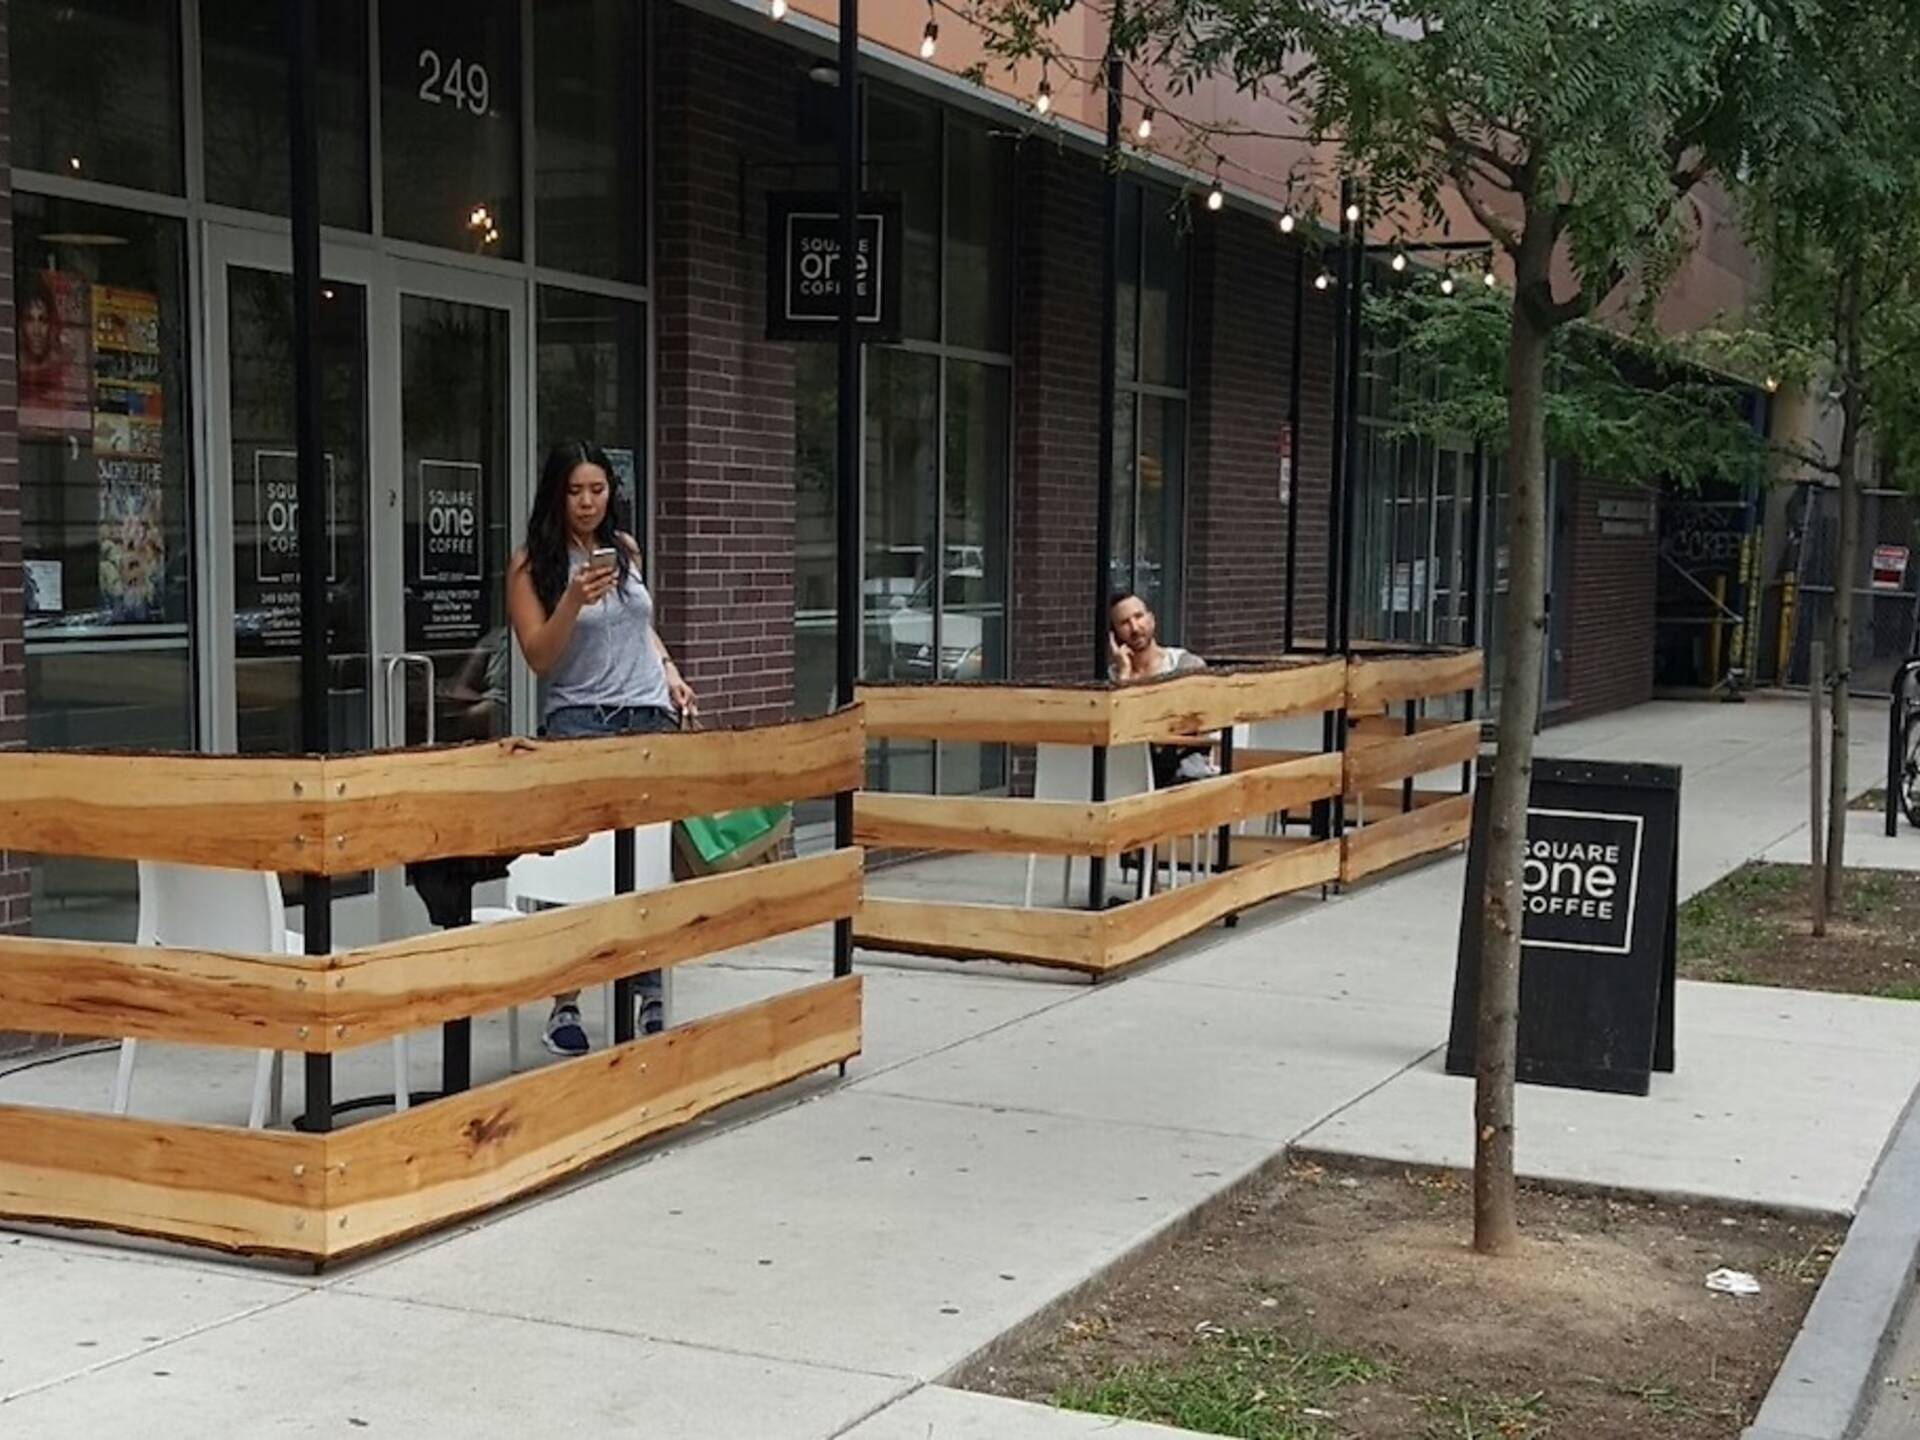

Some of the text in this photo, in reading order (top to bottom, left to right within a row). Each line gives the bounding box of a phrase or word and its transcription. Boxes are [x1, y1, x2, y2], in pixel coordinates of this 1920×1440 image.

[419, 49, 488, 115] 249
[801, 237, 869, 253] SQUE
[800, 280, 867, 296] COFE
[267, 482, 298, 499] SQU
[429, 507, 474, 536] one
[268, 536, 298, 553] COF
[1521, 840, 1619, 863] SQUARE
[1521, 859, 1617, 898] one
